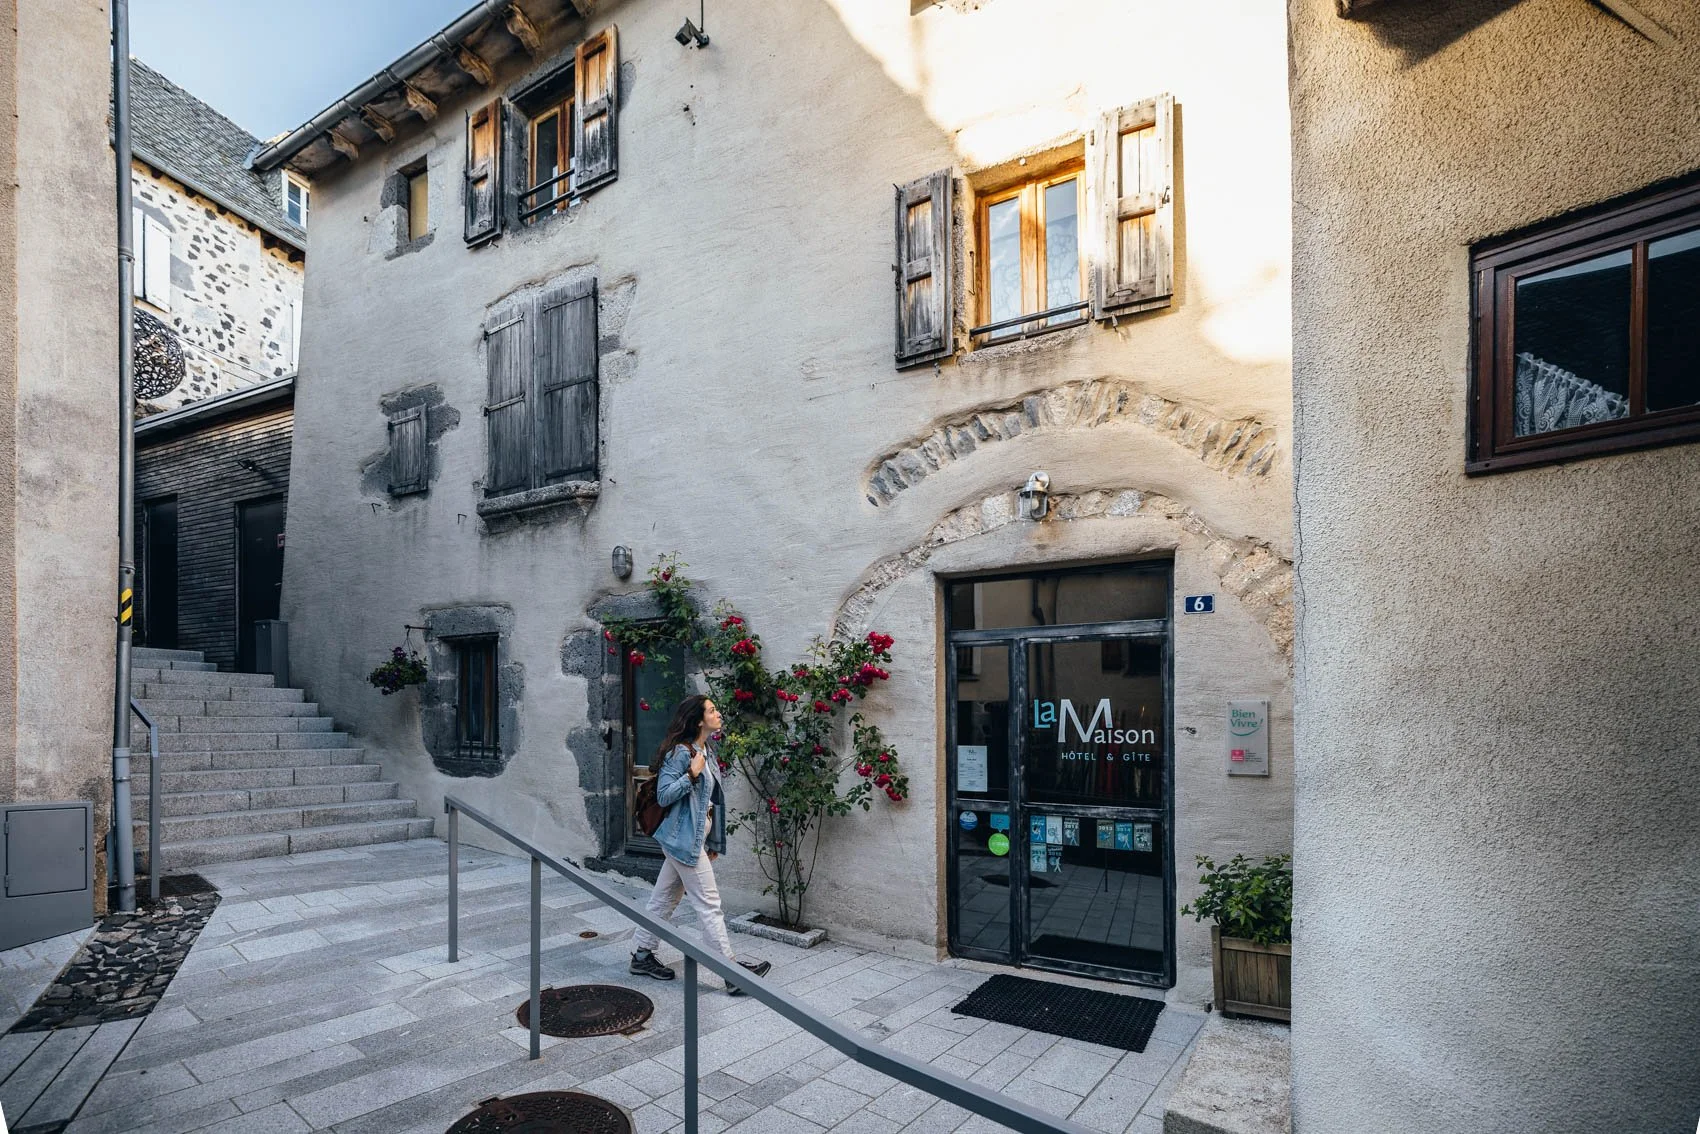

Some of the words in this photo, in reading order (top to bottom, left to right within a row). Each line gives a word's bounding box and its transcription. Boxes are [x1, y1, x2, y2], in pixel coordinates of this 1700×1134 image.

[1193, 597, 1205, 611] 6
[1231, 709, 1256, 718] Bien
[1057, 698, 1155, 744] Maison
[1061, 751, 1097, 761] HÔTEL
[1106, 752, 1114, 761] &
[1123, 751, 1151, 761] GÎTE
